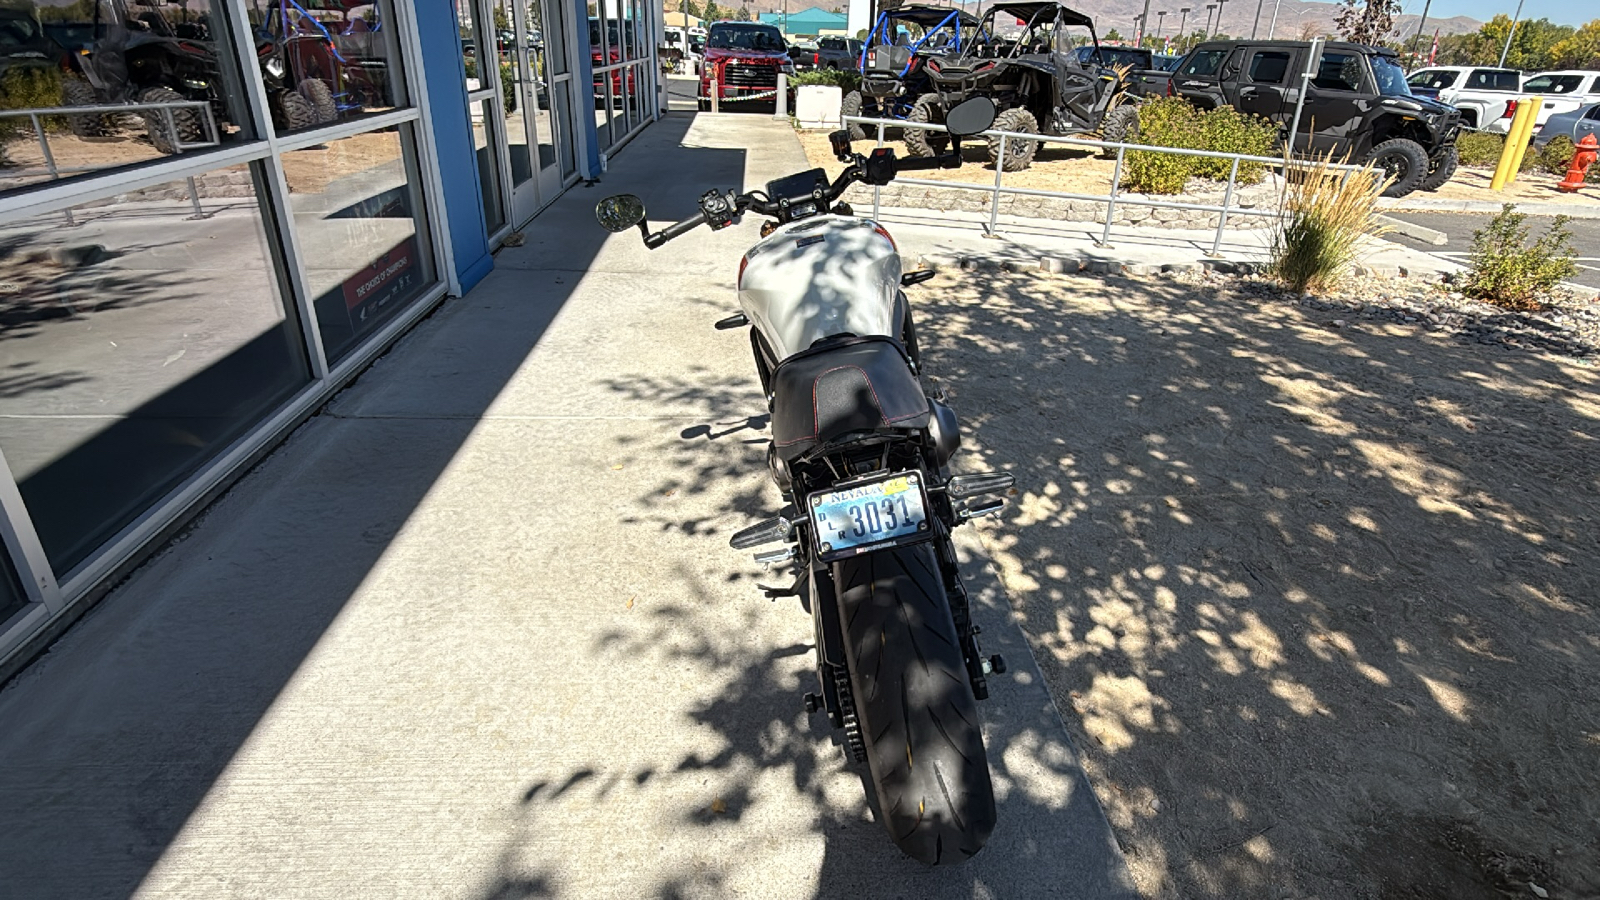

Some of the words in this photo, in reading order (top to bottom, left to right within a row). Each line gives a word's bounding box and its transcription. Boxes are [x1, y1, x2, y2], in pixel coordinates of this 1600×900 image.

[356, 285, 366, 298] THE
[365, 275, 381, 291] CHOICE
[849, 495, 915, 538] 3031
